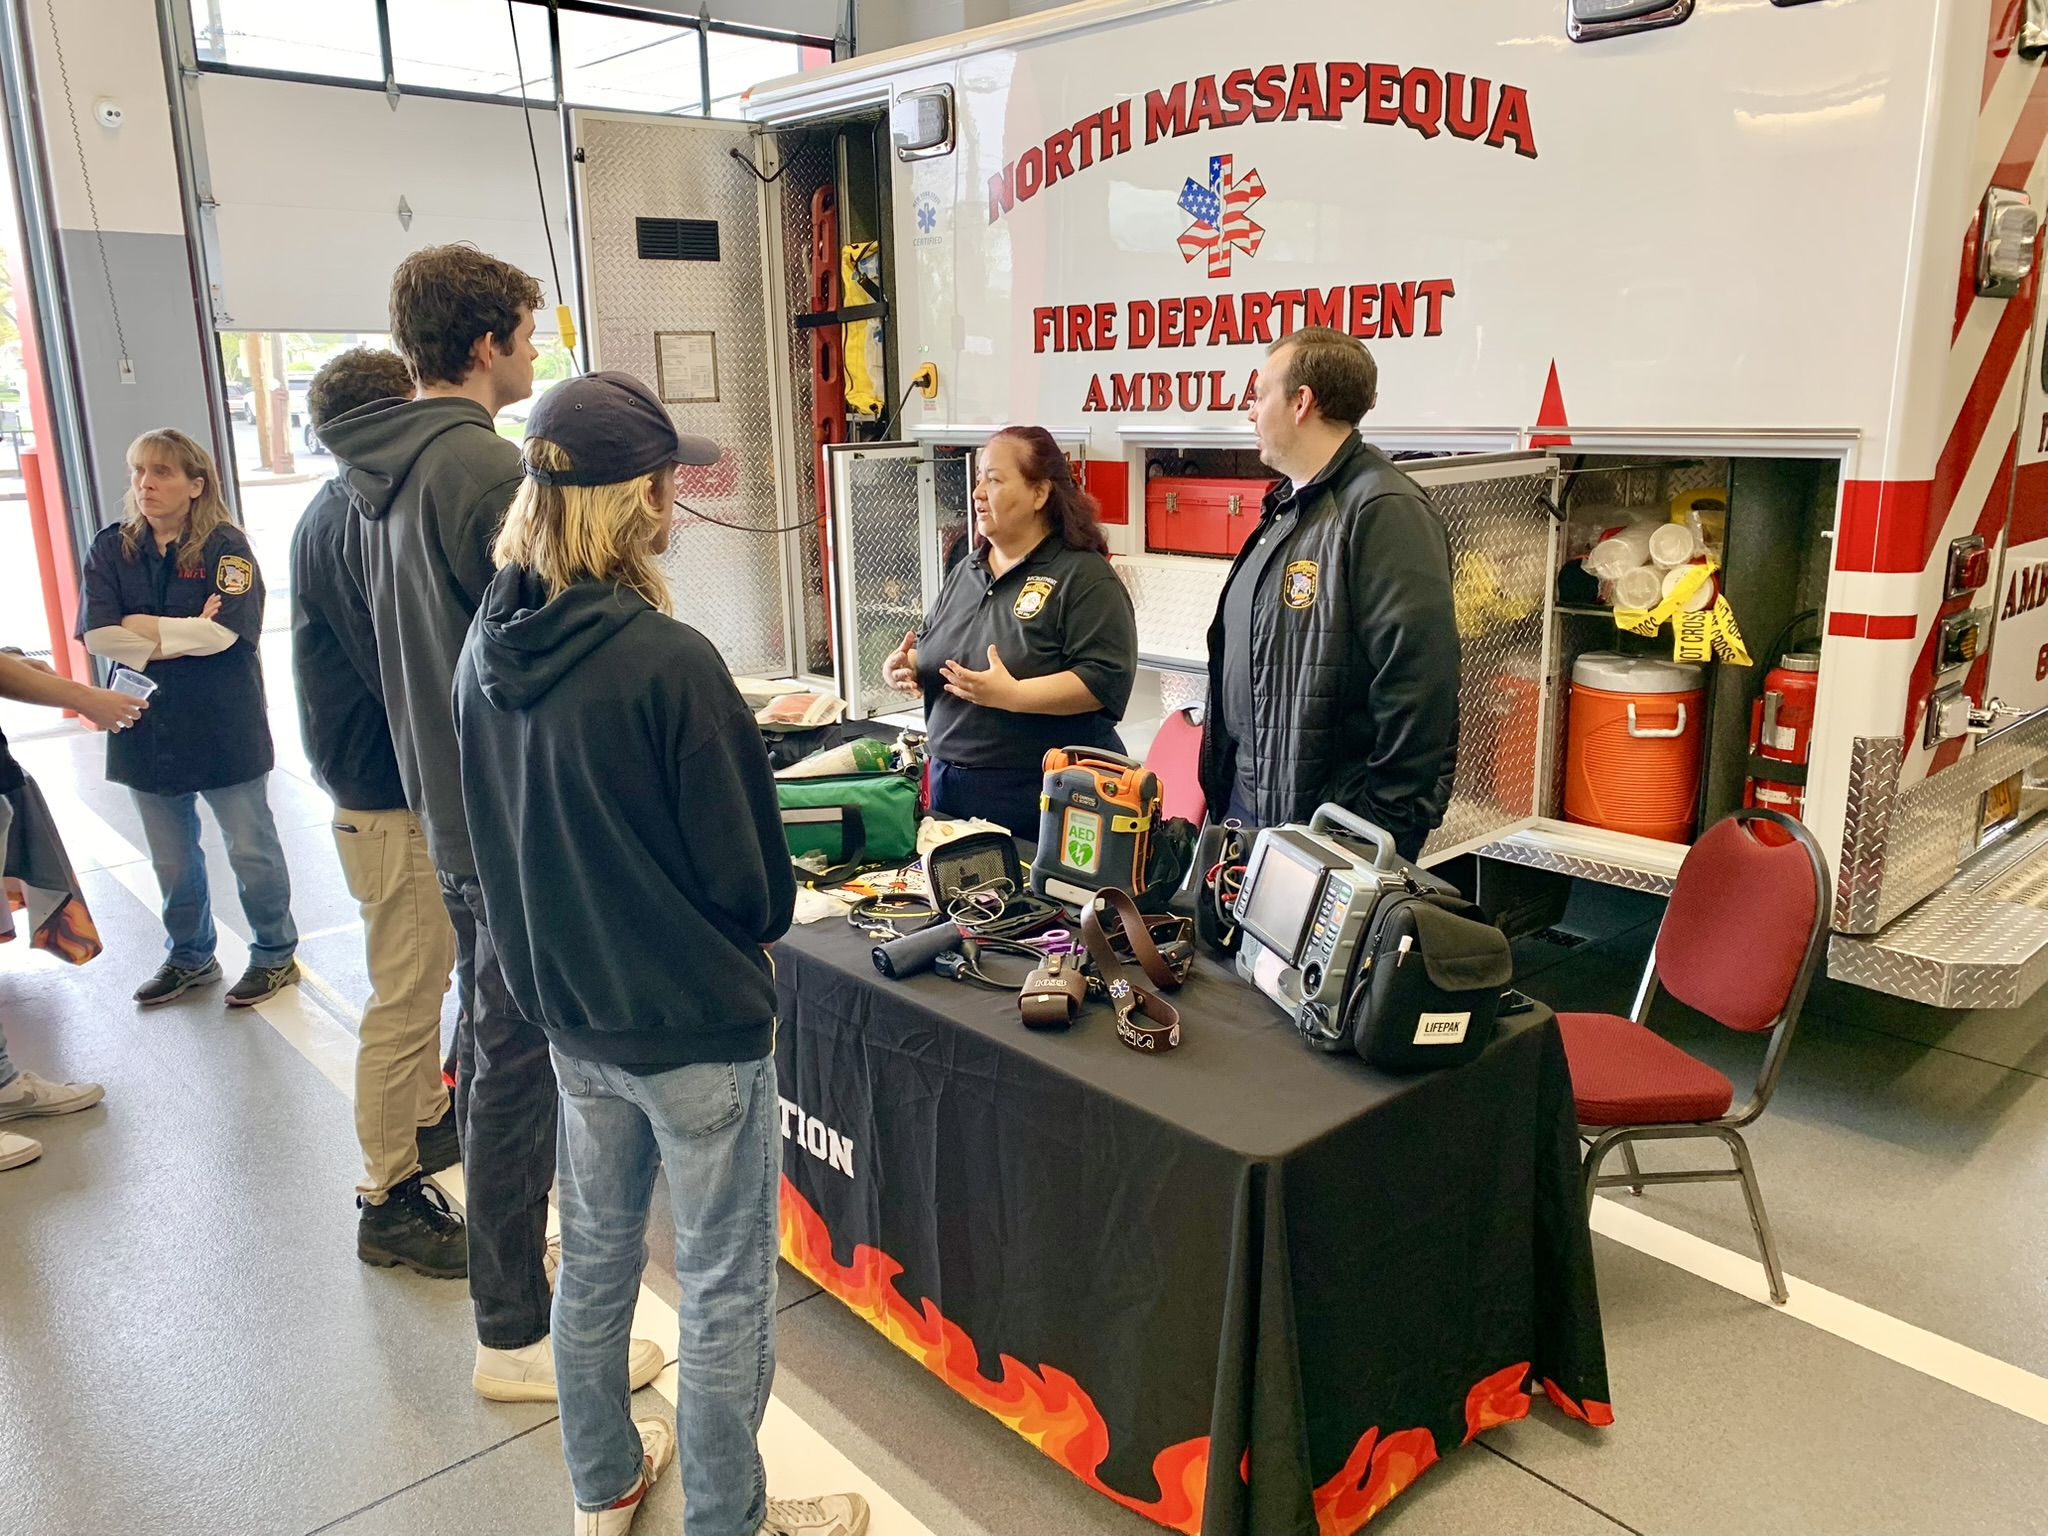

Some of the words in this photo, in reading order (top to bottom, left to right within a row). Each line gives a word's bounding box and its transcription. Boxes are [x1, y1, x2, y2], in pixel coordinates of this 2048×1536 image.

[988, 98, 1132, 226] NORTH
[1145, 61, 1538, 160] MASSAPEQUA
[912, 235, 943, 247] CERTIFIED
[1033, 302, 1118, 354] FIRE
[1127, 278, 1456, 350] DEPARTMENT
[1082, 368, 1262, 413] AMBULA
[1068, 825, 1096, 842] AED
[1424, 1021, 1461, 1033] LIFEPAK
[778, 1094, 855, 1180] TION
